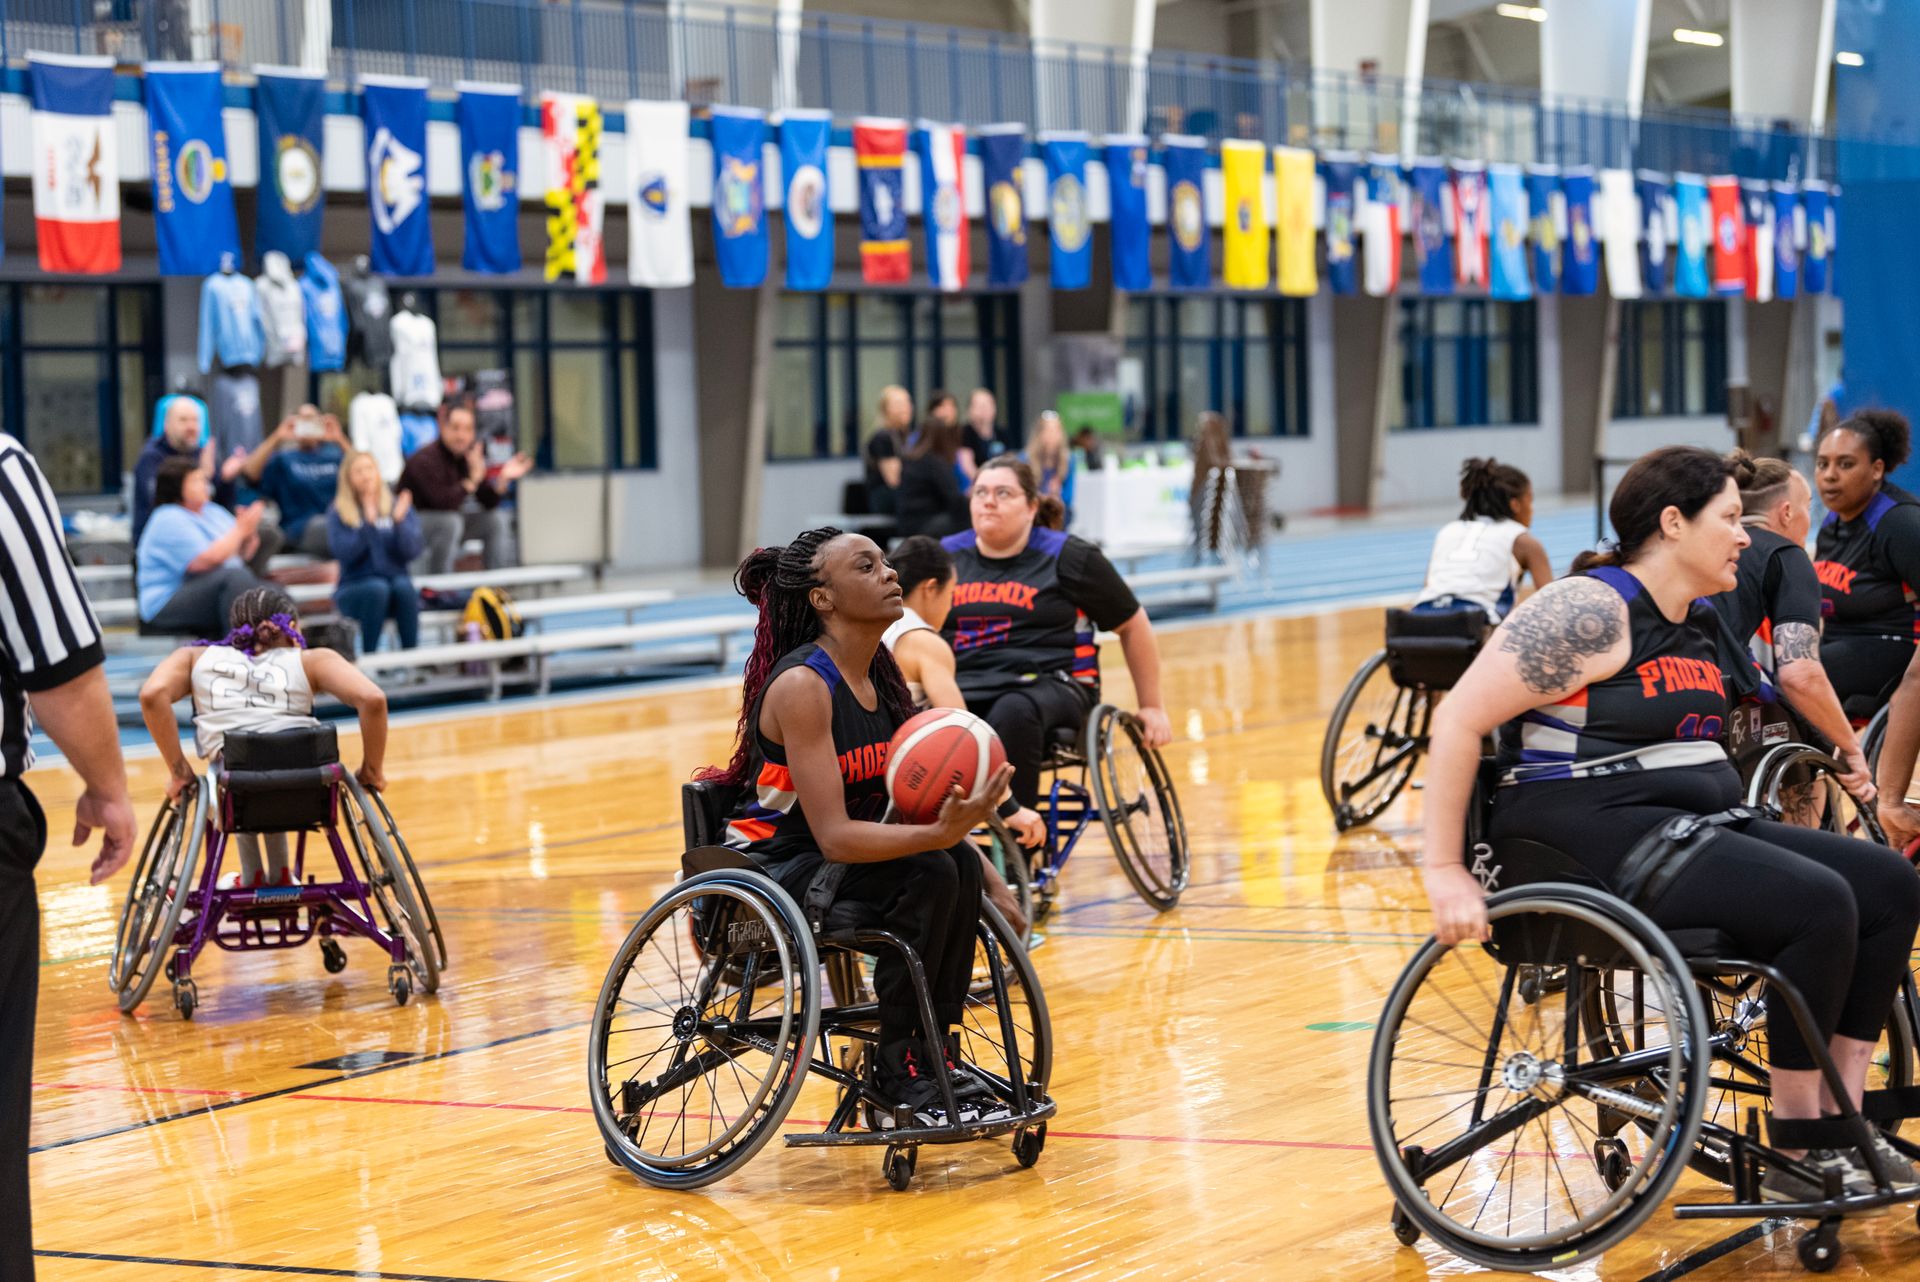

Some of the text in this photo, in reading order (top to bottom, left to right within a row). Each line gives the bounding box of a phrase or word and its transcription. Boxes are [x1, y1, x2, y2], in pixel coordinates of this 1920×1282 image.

[952, 581, 1039, 611] HOENIX
[210, 660, 290, 711] 23
[1636, 656, 1727, 699] PHOEN
[837, 741, 891, 784] PHOE
